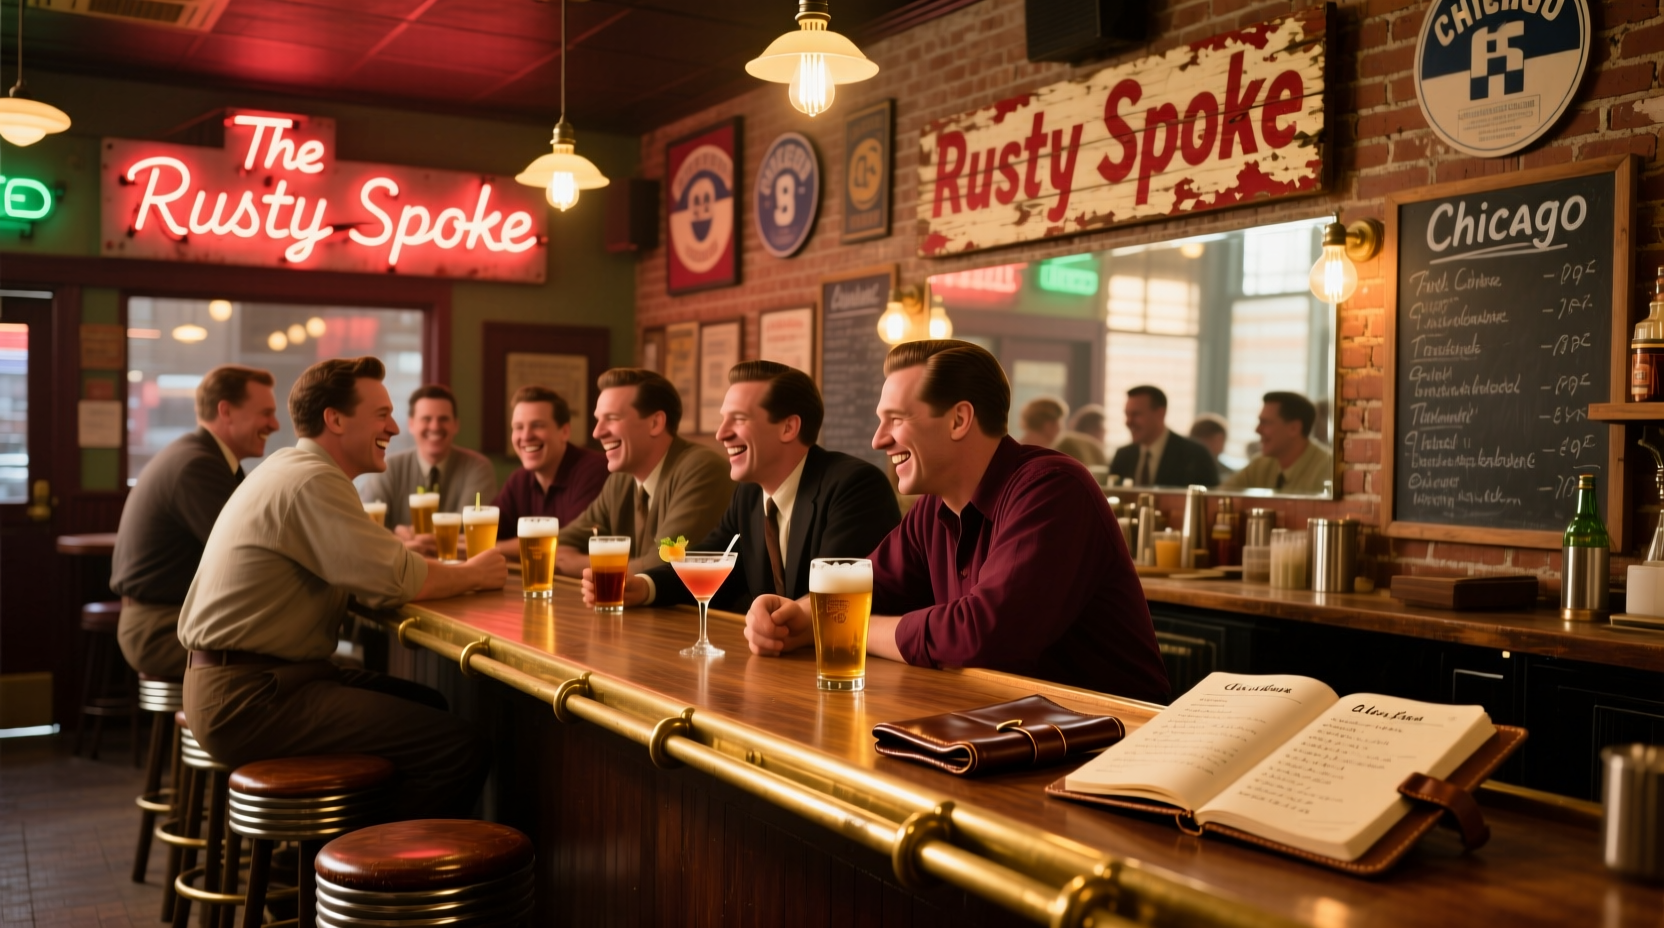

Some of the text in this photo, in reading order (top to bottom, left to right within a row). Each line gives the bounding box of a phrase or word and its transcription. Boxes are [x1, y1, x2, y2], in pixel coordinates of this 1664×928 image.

[233, 114, 326, 174] The
[931, 50, 1304, 223] Rusty Spoke
[126, 156, 335, 264] Rusty
[348, 176, 538, 266] Spoke
[773, 172, 797, 227] 9
